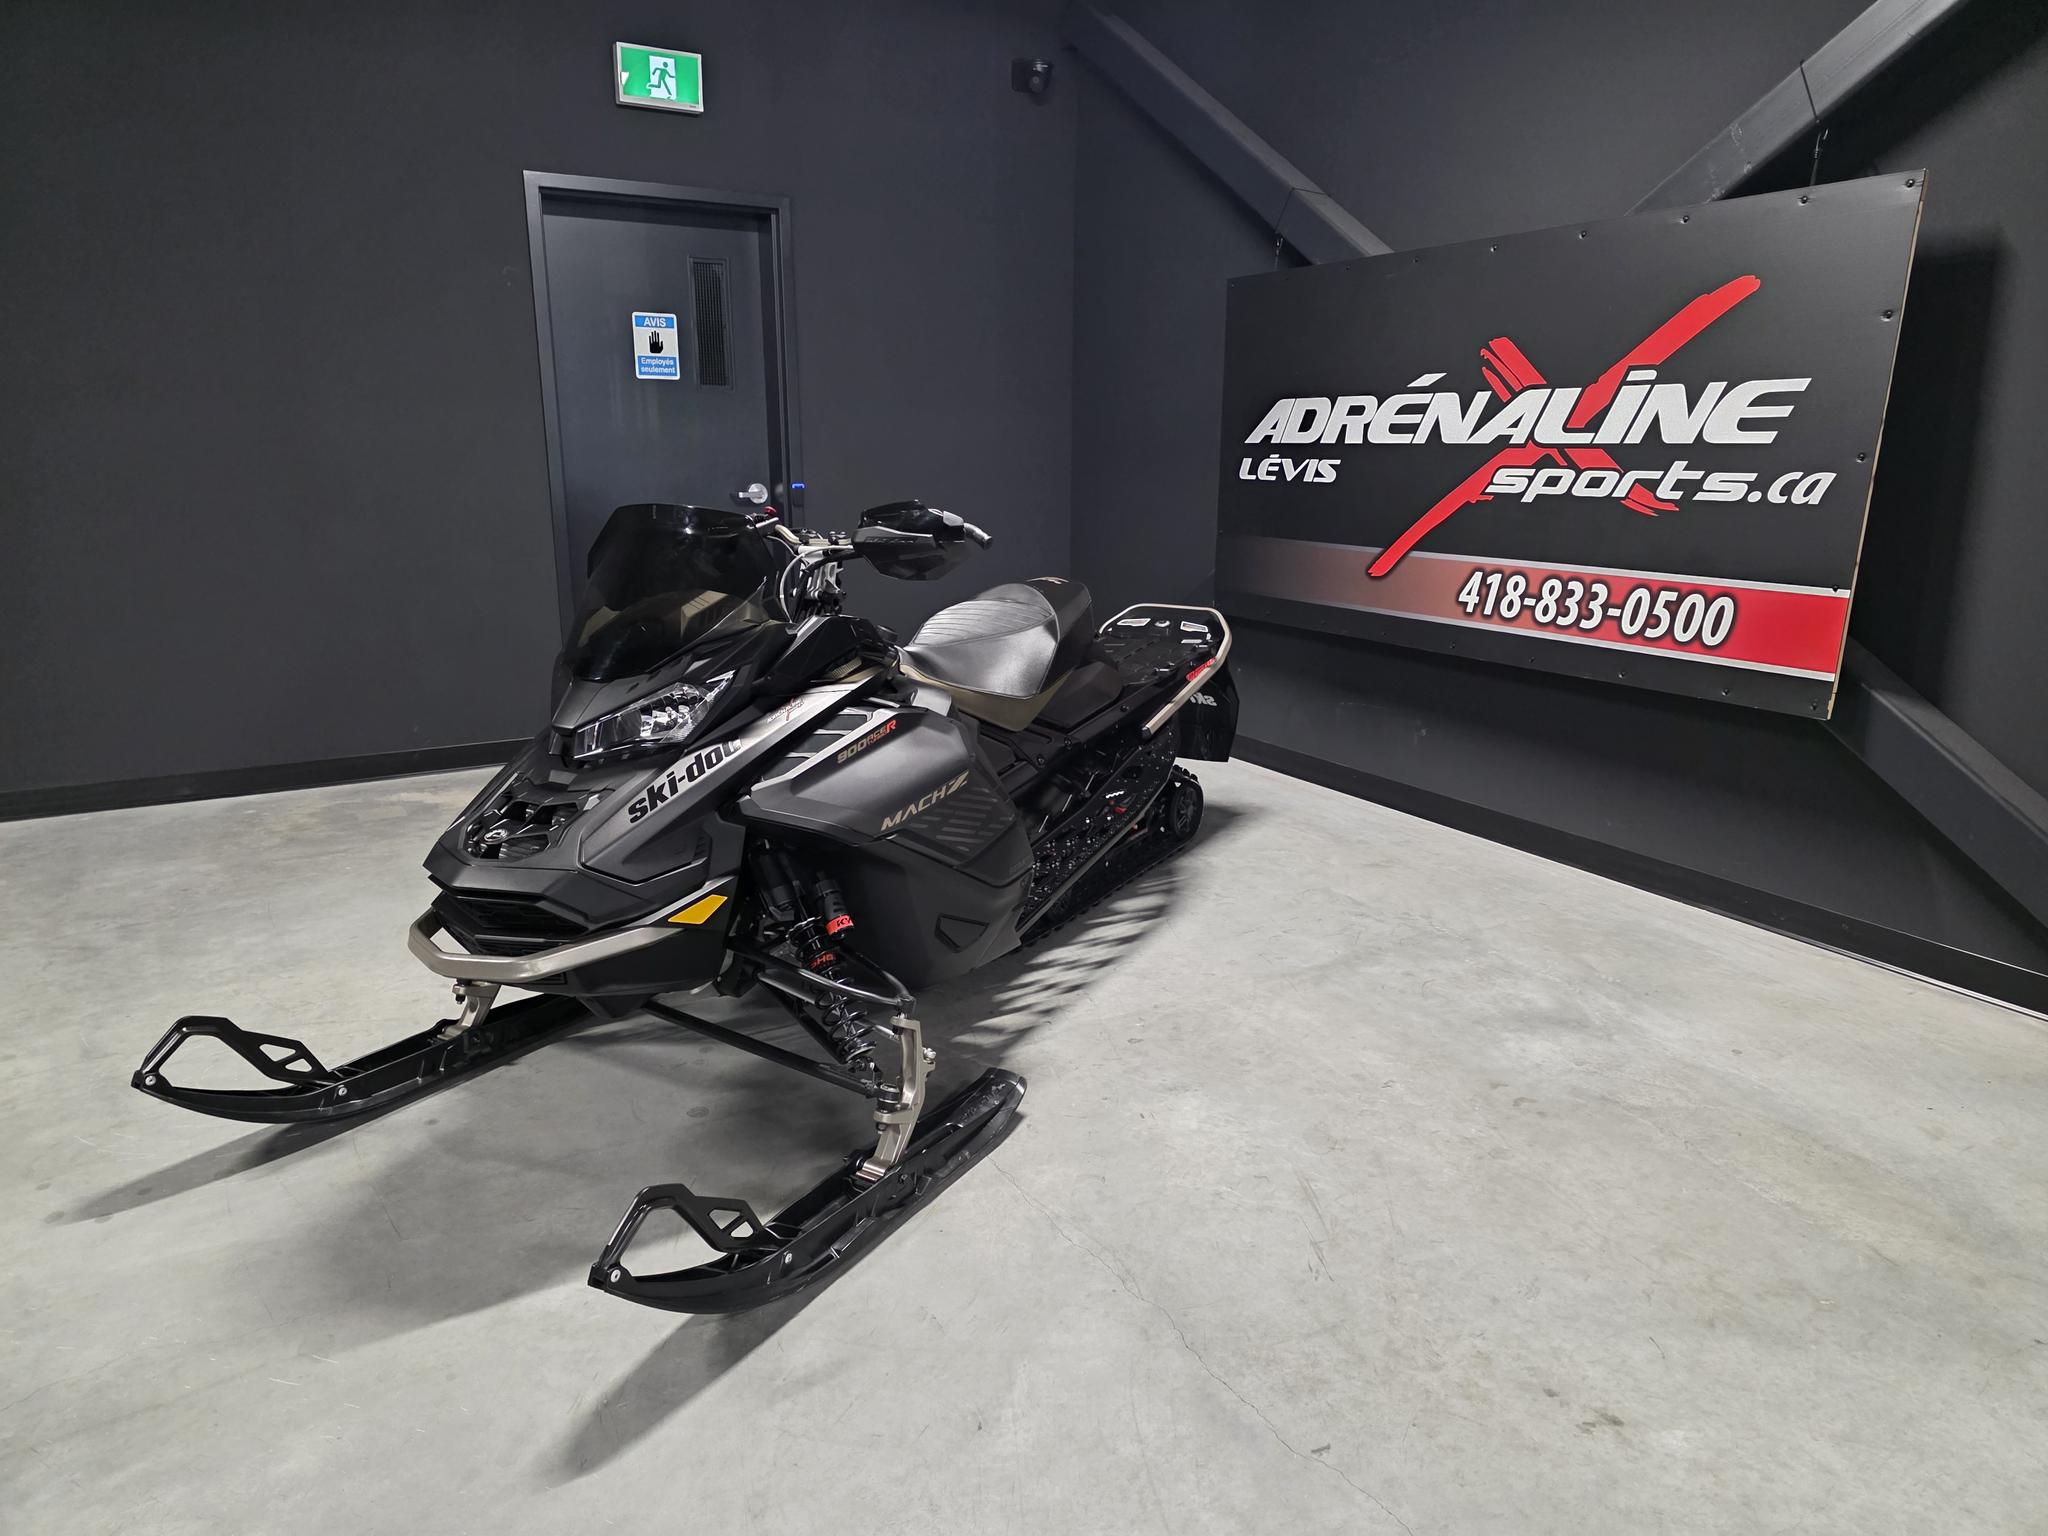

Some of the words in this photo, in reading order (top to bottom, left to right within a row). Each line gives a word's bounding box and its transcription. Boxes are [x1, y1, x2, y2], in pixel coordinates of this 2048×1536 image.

[643, 317, 667, 328] AVIS
[640, 357, 674, 367] Employés
[640, 366, 676, 374] seulement
[1244, 369, 1812, 445] ADRÉNALINE
[1238, 453, 1342, 483] LÉVIS
[1485, 460, 1837, 505] sports.ca
[1457, 571, 1736, 647] 418-833-0500
[837, 738, 868, 764] 900
